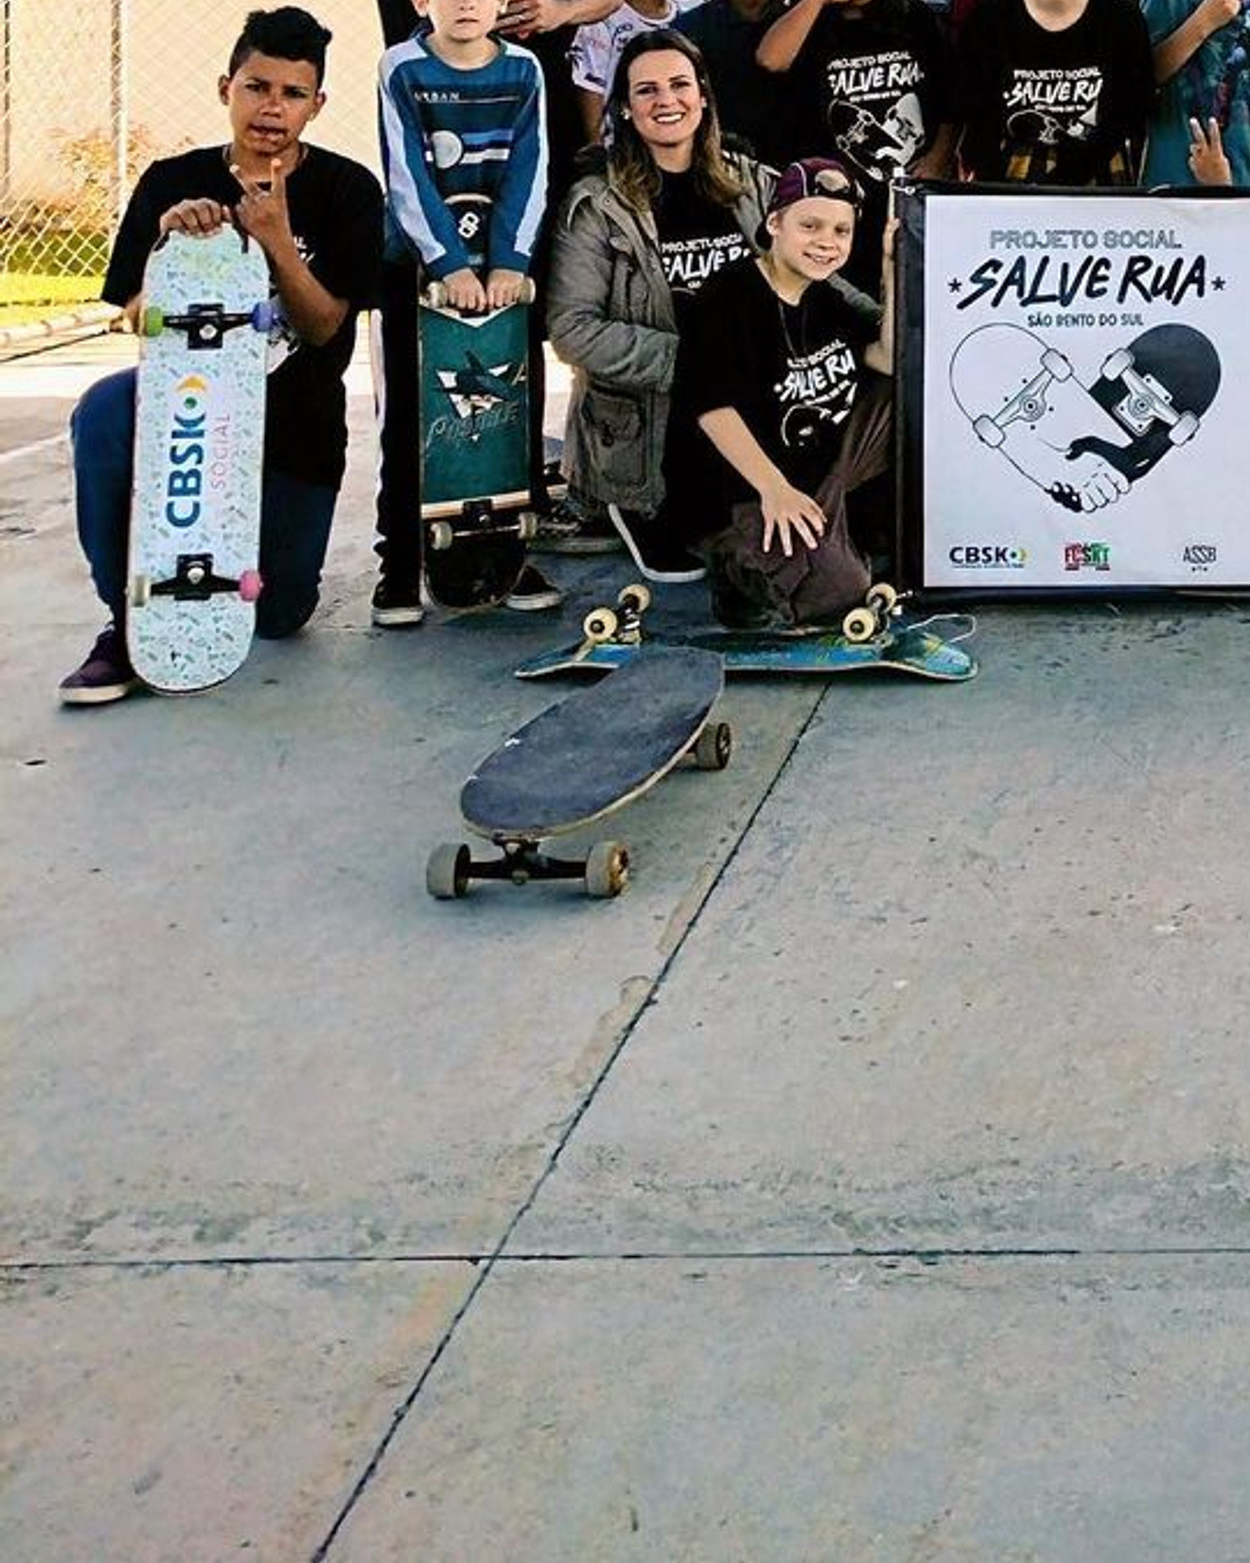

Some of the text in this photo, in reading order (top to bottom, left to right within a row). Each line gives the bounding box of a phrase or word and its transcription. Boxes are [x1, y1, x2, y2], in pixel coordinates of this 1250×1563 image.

[1013, 69, 1064, 80] PROJETO
[1007, 77, 1103, 107] SALVE RU
[989, 229, 1182, 249] PROJETO SOCIAL
[956, 254, 1206, 310] SALVE RUA
[1027, 312, 1144, 328] SÃO BENTO DO SUL
[211, 413, 230, 491] SOCIAL
[165, 411, 206, 528] CBSK
[949, 546, 1008, 564] CBSK
